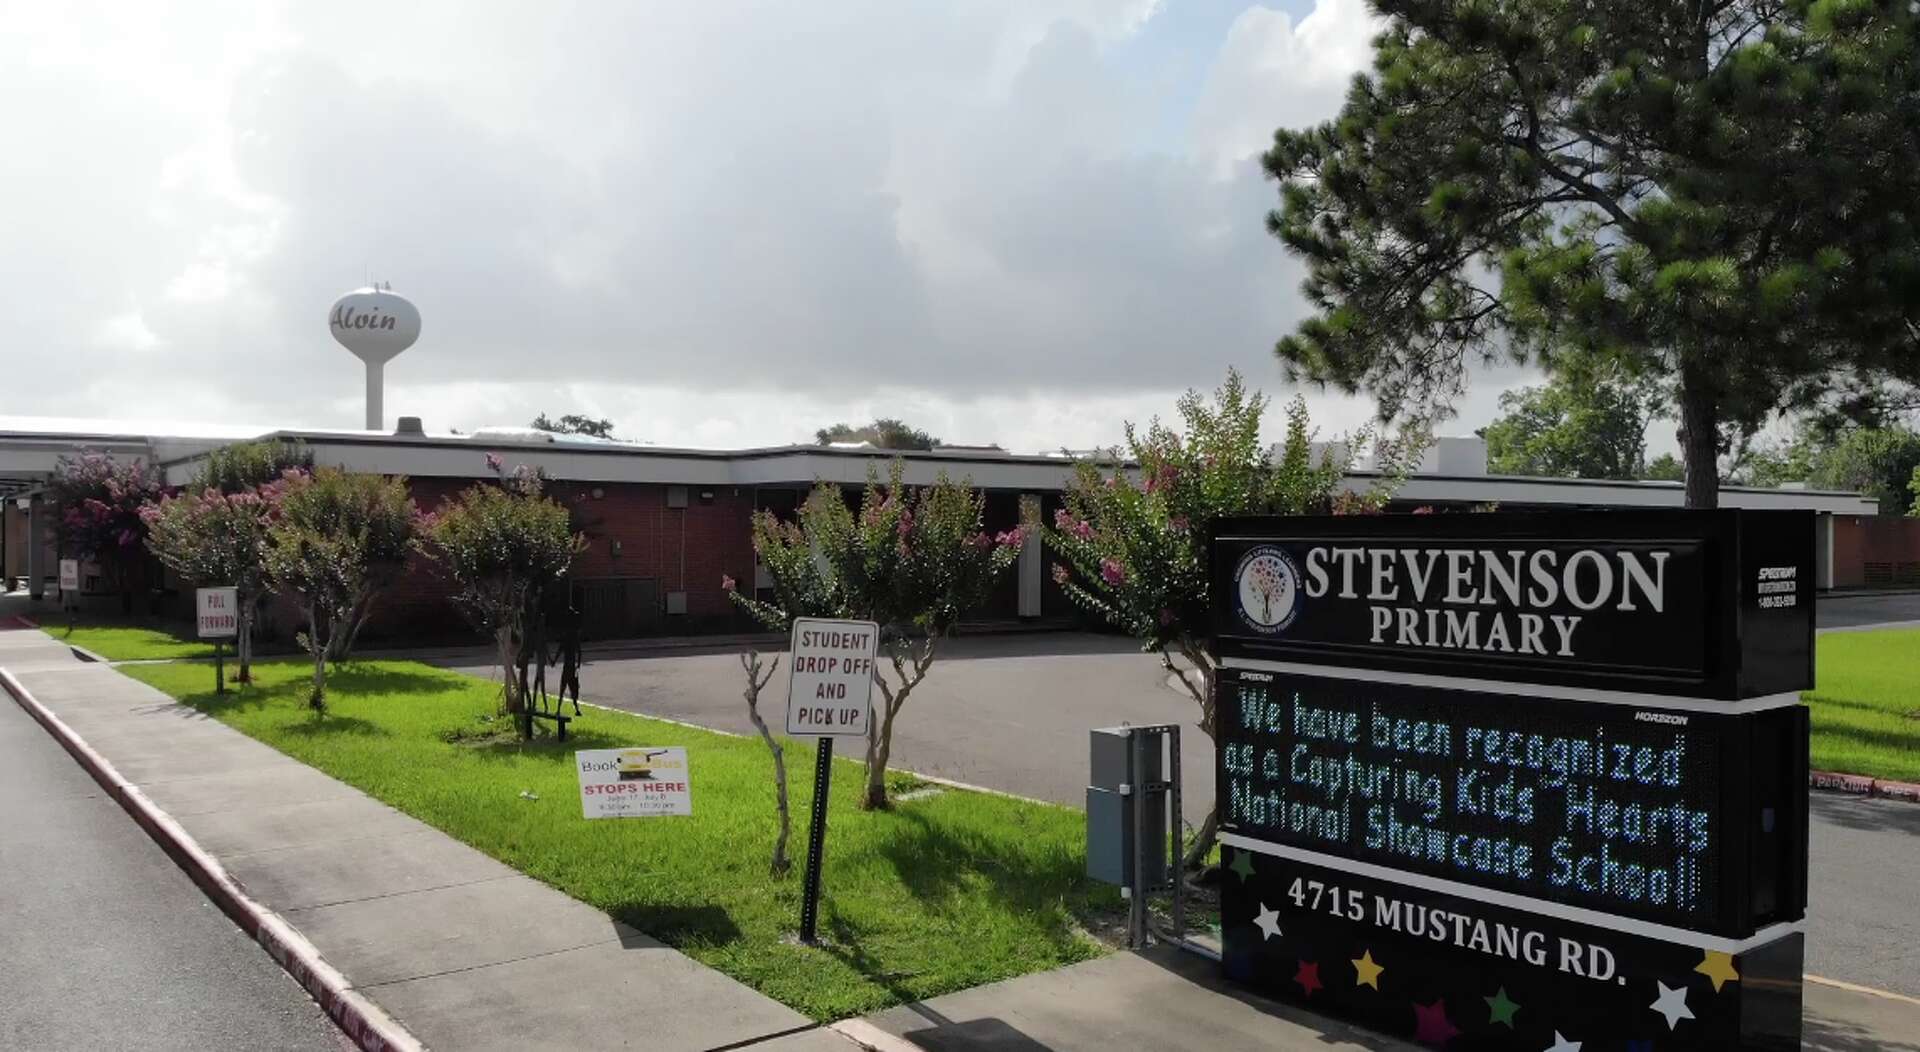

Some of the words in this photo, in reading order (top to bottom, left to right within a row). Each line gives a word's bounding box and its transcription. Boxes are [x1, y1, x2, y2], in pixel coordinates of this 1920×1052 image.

[1304, 546, 1671, 612] STEVENSON
[802, 630, 870, 650] STUDENT
[1370, 605, 1583, 656] PRIMARY
[796, 656, 837, 674] DROP
[843, 658, 871, 675] OFF
[816, 682, 846, 699] AND
[798, 707, 834, 726] PICK
[840, 708, 859, 725] UP
[1238, 685, 1281, 735] We
[1293, 691, 1361, 744] have
[1371, 701, 1451, 758] been
[1465, 726, 1686, 788] recognized
[582, 760, 619, 772] Book
[584, 782, 638, 796] STOPS
[643, 782, 687, 792] HERE
[1224, 742, 1254, 777] as
[1263, 748, 1279, 780] a
[1291, 743, 1442, 824] Capturing
[1566, 782, 1708, 852] Hearts
[1230, 778, 1350, 843] National
[1365, 803, 1534, 880] Showcase
[1287, 877, 1364, 922] 4715
[1374, 895, 1547, 965] MUSTANG
[1559, 937, 1627, 986] RD.
